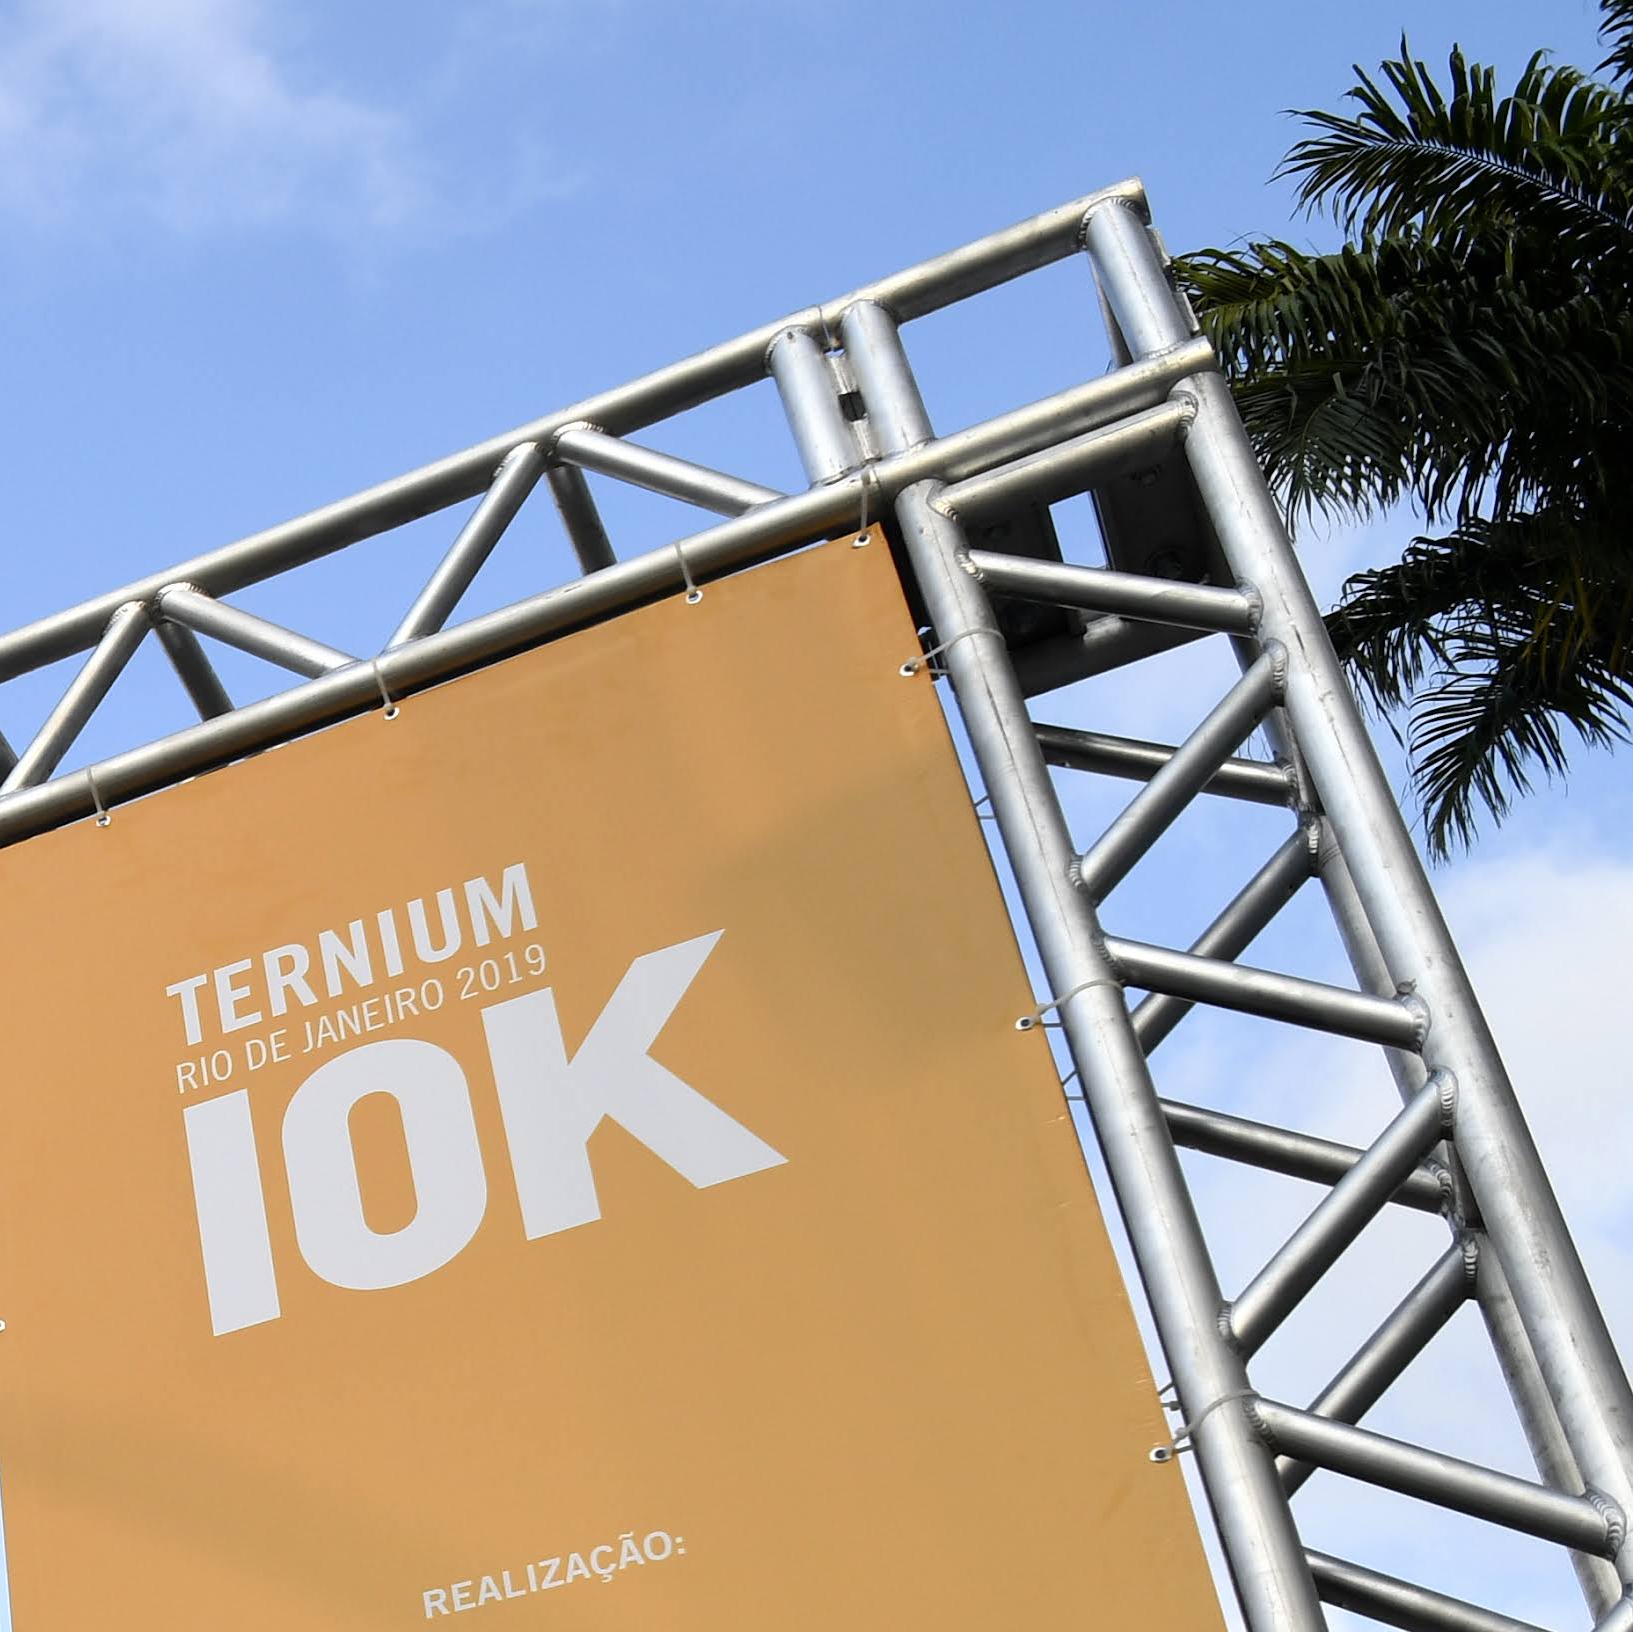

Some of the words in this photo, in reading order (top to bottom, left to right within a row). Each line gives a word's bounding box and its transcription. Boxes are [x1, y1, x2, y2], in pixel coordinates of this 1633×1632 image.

[166, 863, 539, 1046] TERNIUM
[176, 1050, 234, 1094] RIO
[245, 1031, 291, 1071] DE
[301, 980, 445, 1053] JANEIRO
[456, 943, 547, 1001] 2019
[422, 1529, 686, 1619] REALIZAÇÃO:
